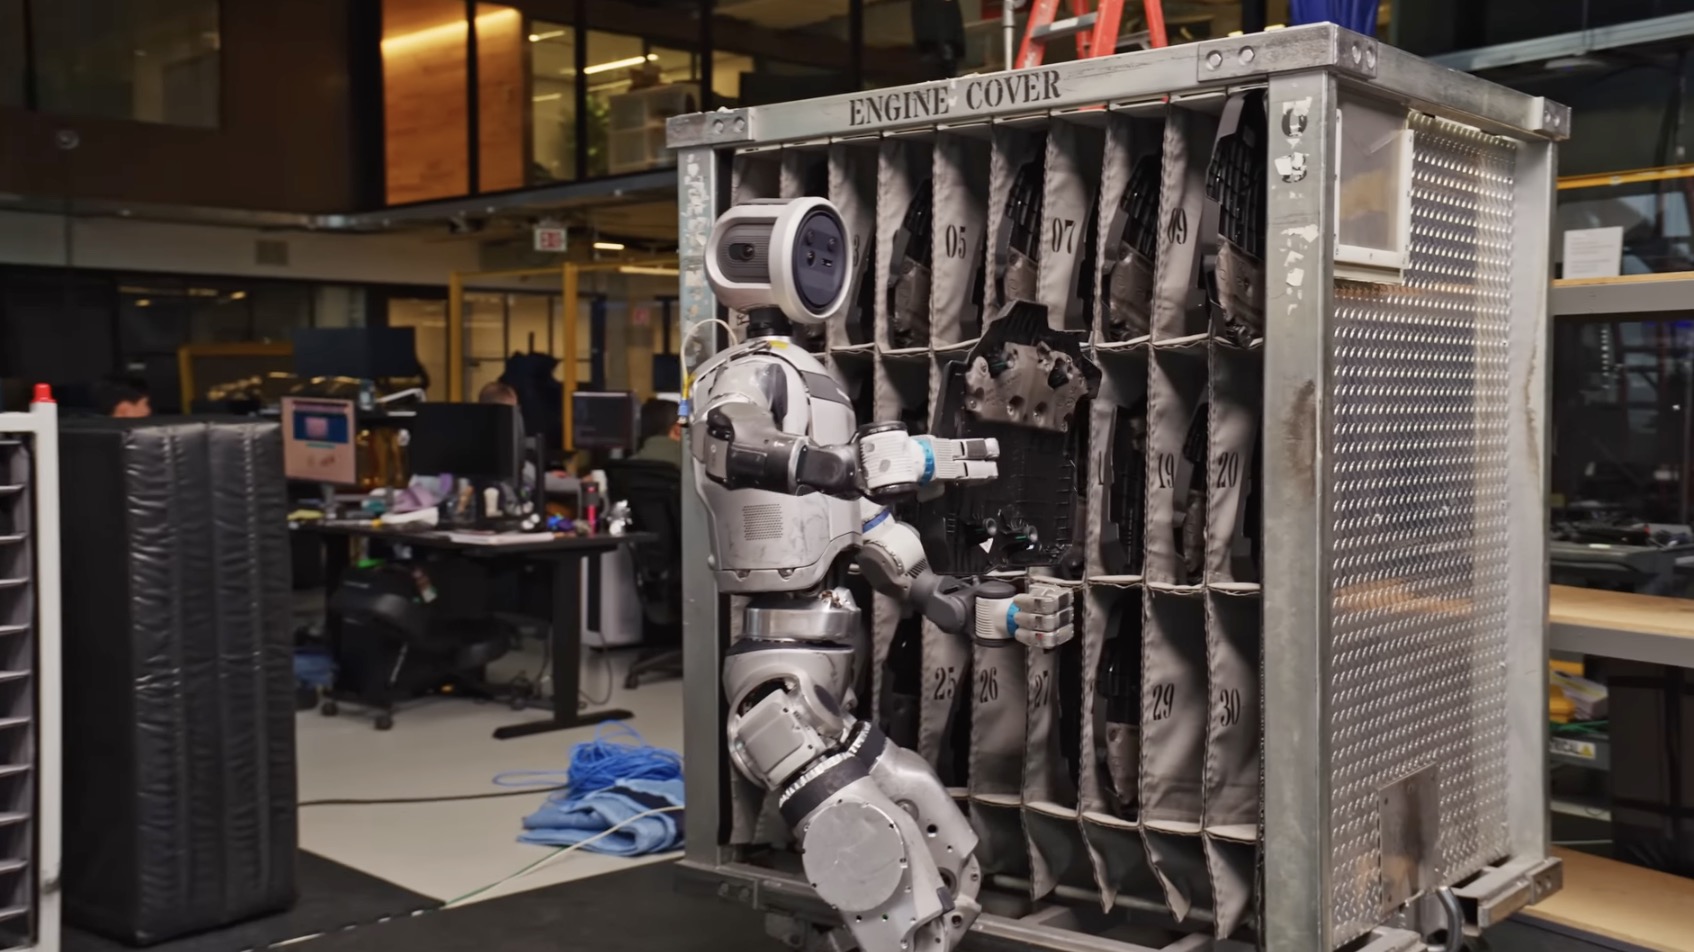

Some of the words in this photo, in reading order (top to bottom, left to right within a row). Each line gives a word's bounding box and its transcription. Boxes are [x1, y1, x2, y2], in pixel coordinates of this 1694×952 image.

[849, 86, 950, 126] ENGINE
[966, 70, 1061, 110] COVER
[945, 224, 967, 259] 05
[1051, 217, 1076, 254] 07
[1167, 207, 1188, 245] 09
[853, 234, 860, 268] 3
[1097, 450, 1105, 486] 1
[1158, 452, 1175, 489] 19
[1216, 451, 1239, 489] 20
[933, 666, 956, 700] 25
[979, 666, 998, 703] 26
[1033, 670, 1049, 708] 27
[1152, 683, 1175, 721] 29
[1219, 688, 1240, 727] 30
